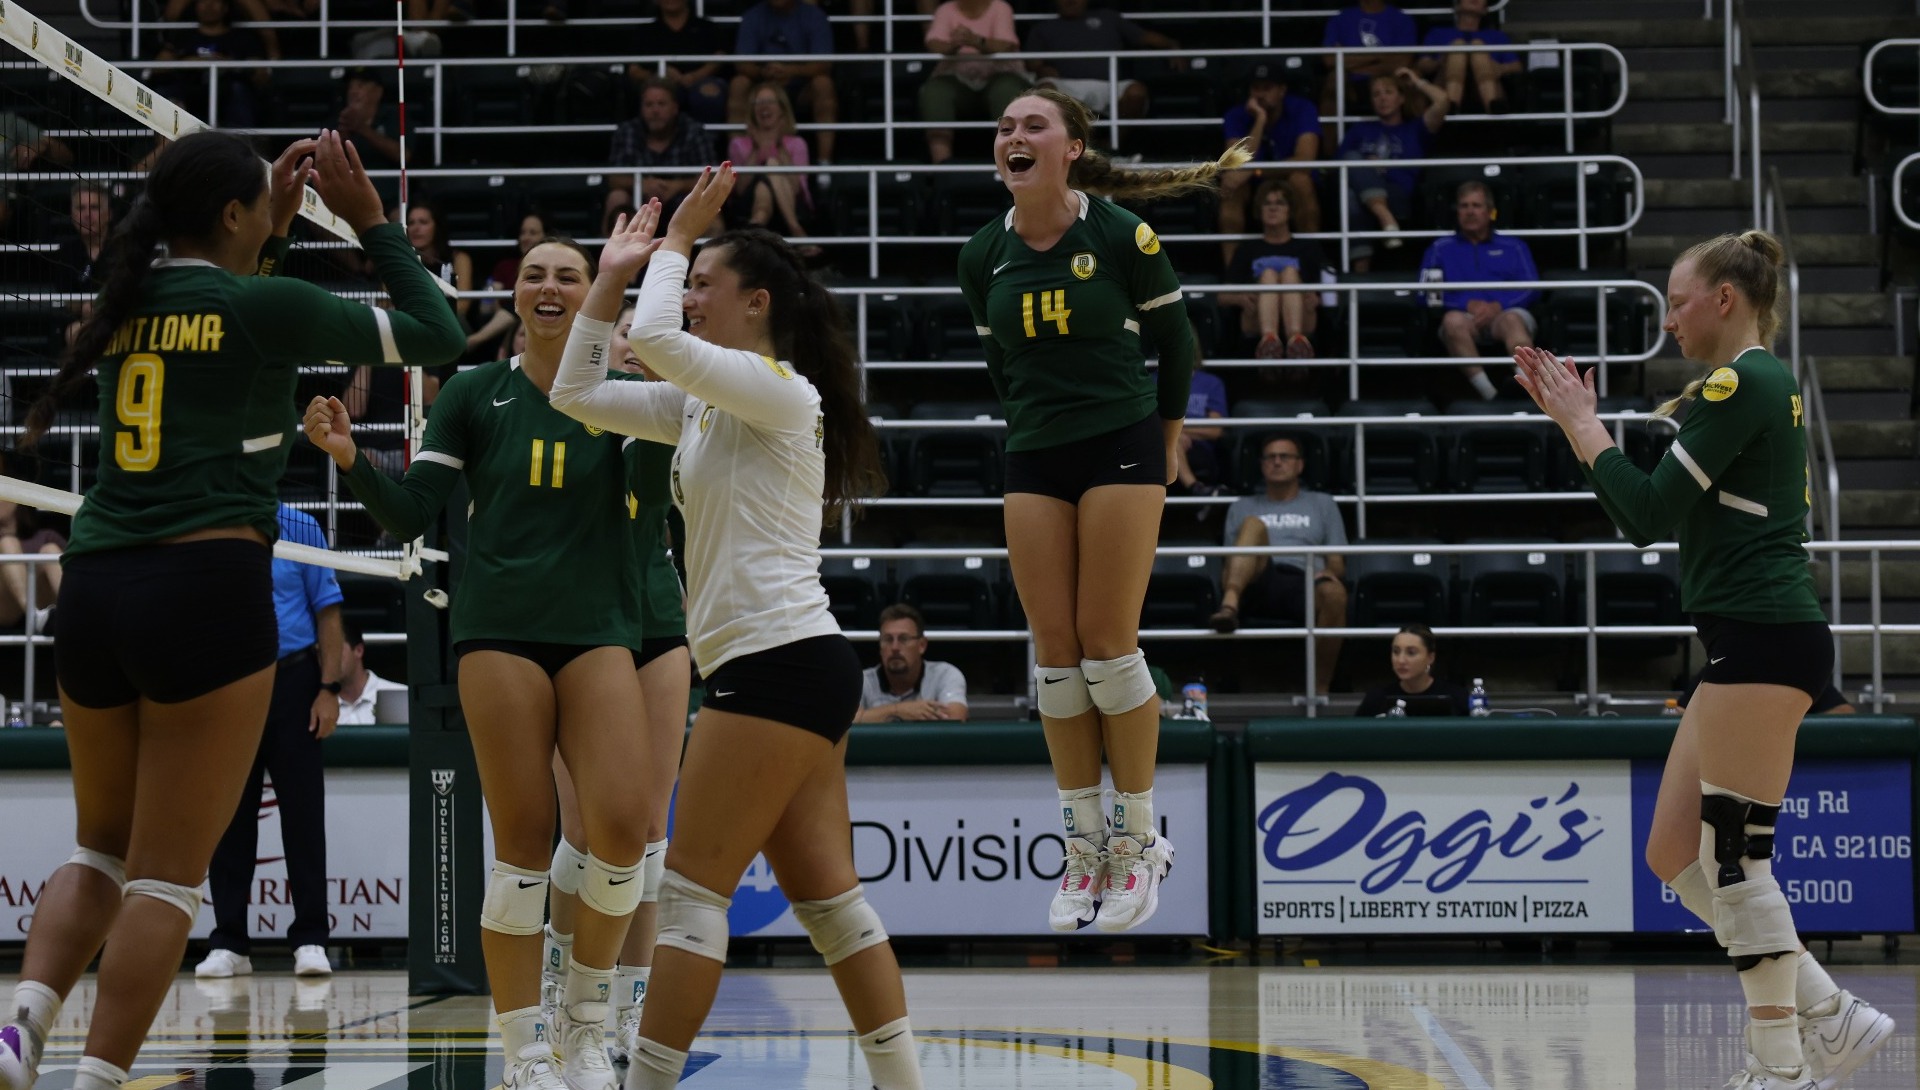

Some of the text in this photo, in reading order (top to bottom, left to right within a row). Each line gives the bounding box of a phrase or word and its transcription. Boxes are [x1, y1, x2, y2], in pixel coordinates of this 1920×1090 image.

[149, 314, 225, 351] LOMA
[1023, 290, 1072, 337] 14
[590, 344, 603, 366] JOY
[115, 353, 165, 472] 9
[530, 439, 565, 488] 11
[1818, 790, 1849, 814] Rd
[850, 818, 1067, 884] Divisio
[1257, 771, 1604, 895] Oggi's
[1792, 835, 1827, 860] CA
[1834, 835, 1912, 860] 92106
[1263, 900, 1589, 919] SPORTS LIBERTY STATION PIZZA
